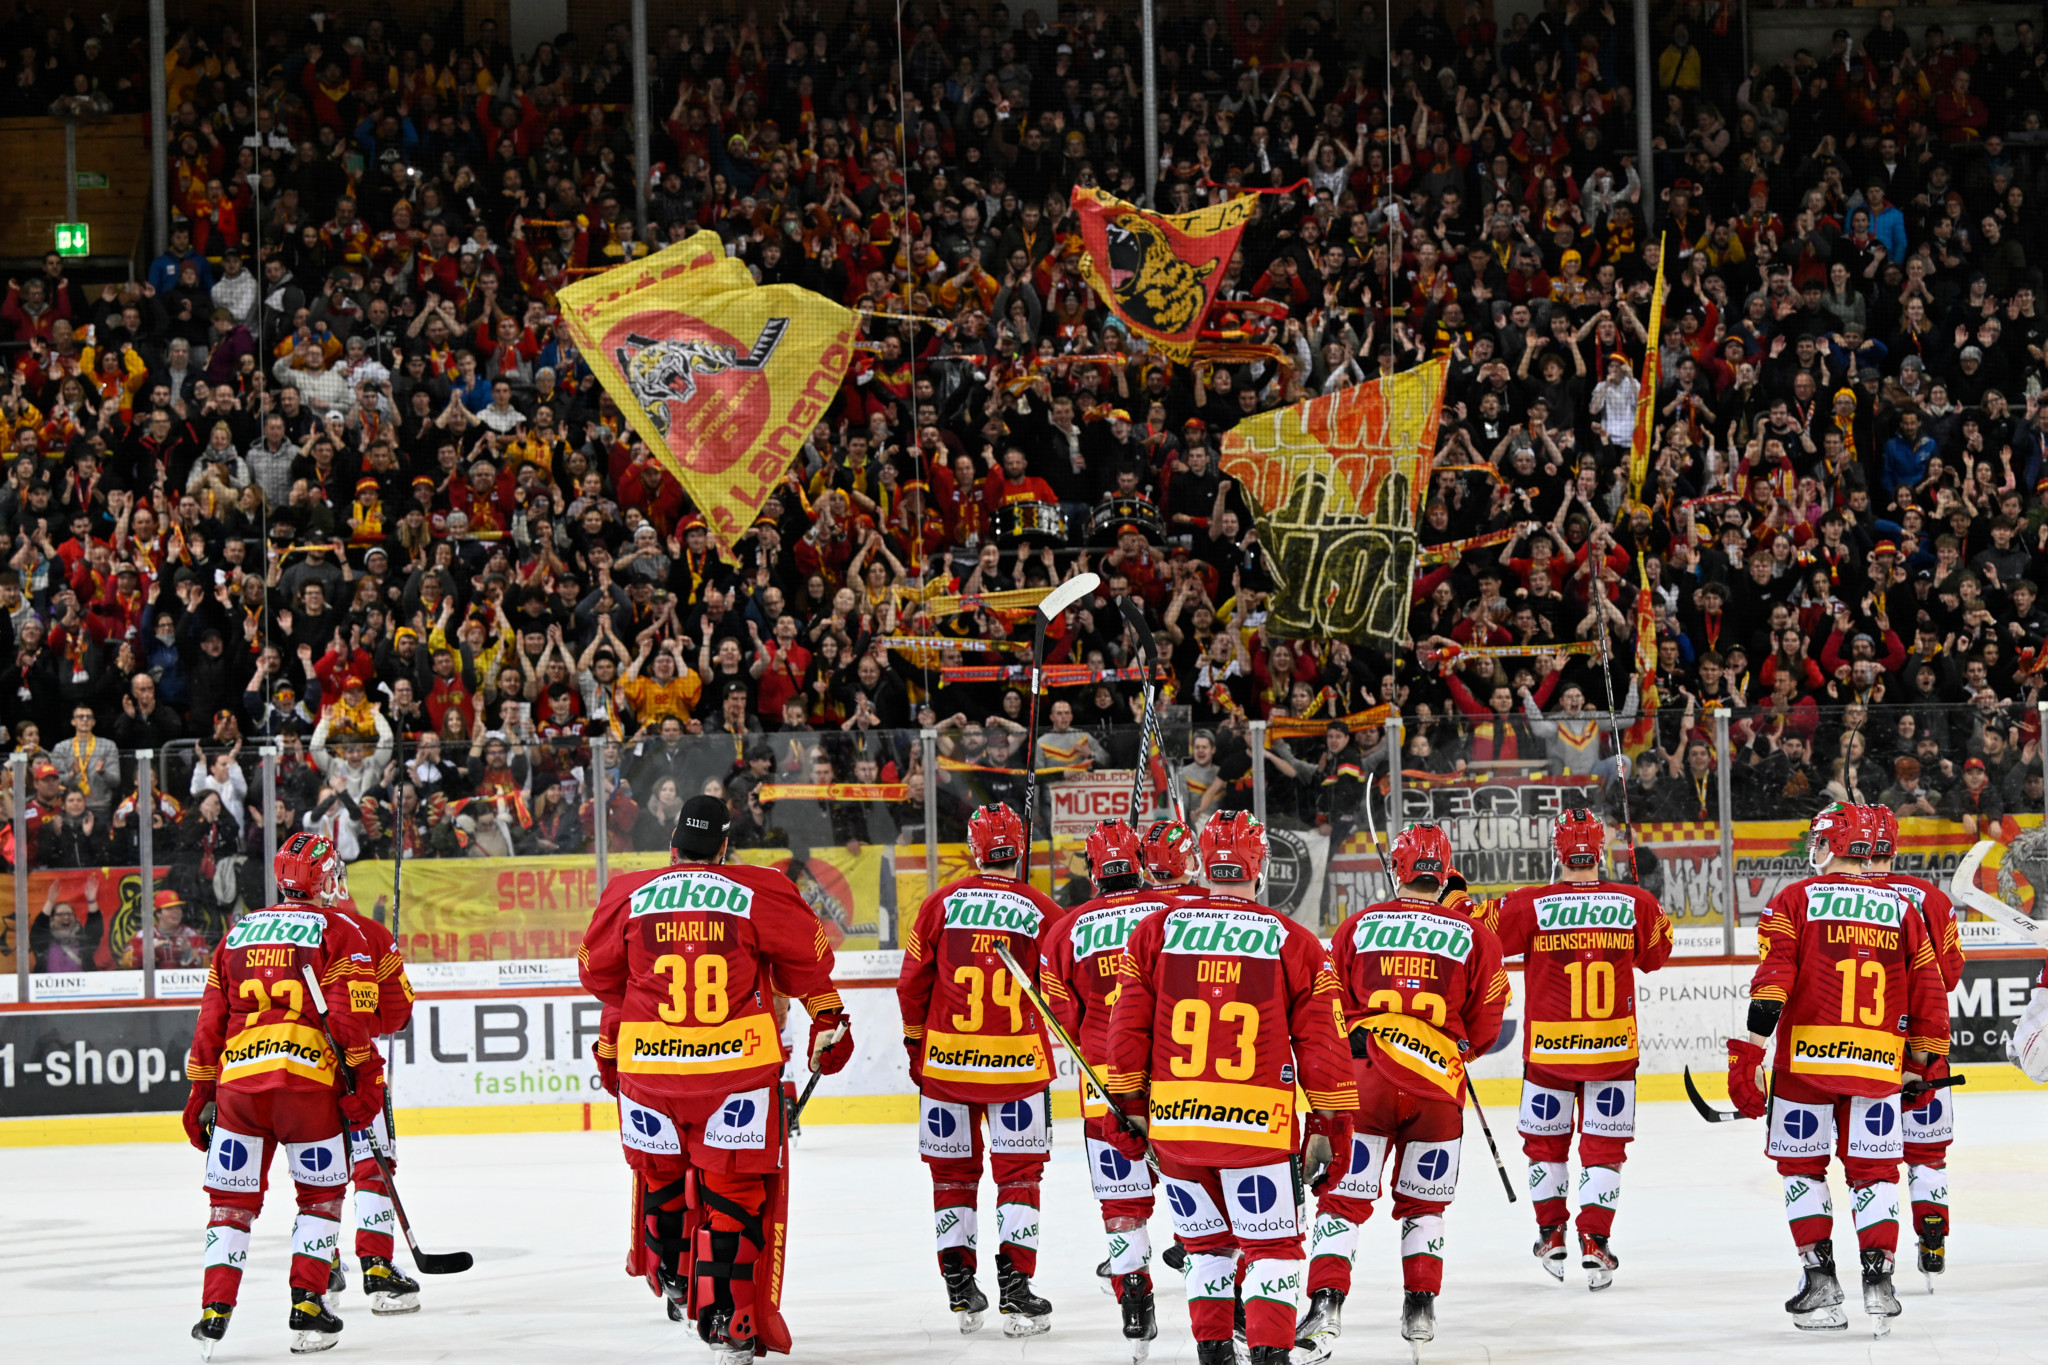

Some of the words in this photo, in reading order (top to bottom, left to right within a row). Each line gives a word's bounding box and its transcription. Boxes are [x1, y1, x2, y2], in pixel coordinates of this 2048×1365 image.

[633, 879, 750, 913] Jakob
[945, 898, 1039, 935] Jakob
[1540, 902, 1635, 927] Jakob
[2013, 917, 2039, 932] LITE
[227, 919, 321, 947] Jakob
[656, 921, 724, 943] CHARLIN
[1162, 918, 1281, 956] Jakob
[1358, 921, 1471, 958] Jakob
[1827, 925, 1899, 950] LAPINSKIS
[246, 948, 295, 968] SCHILT
[1380, 956, 1438, 980] WEIBEL
[1197, 959, 1242, 984] DIEM
[654, 954, 729, 1024] 38
[952, 966, 1022, 1033] 34
[1564, 961, 1615, 1019] 10
[1836, 958, 1886, 1027] 13
[225, 1038, 321, 1063] PostFinance
[634, 1037, 743, 1057] PostFinance
[1170, 998, 1260, 1081] 93
[1535, 1033, 1628, 1051] PostFinance
[929, 1045, 1035, 1067] PostFinance
[1795, 1039, 1895, 1066] PostFinance
[474, 1069, 581, 1095] fashion
[1150, 1098, 1269, 1127] PostFinance
[1520, 1118, 1570, 1132] elvadata
[706, 1131, 764, 1144] elvadata
[1584, 1119, 1632, 1133] elvadata
[624, 1132, 679, 1151] elvadata
[920, 1139, 970, 1153] elvadata
[992, 1136, 1046, 1149] elvadata
[1771, 1140, 1829, 1153] elvadata
[1850, 1139, 1901, 1152] elvadata
[208, 1171, 259, 1188] elvadata
[1400, 1179, 1454, 1196] elvadata
[771, 1222, 784, 1306] VAUGHN
